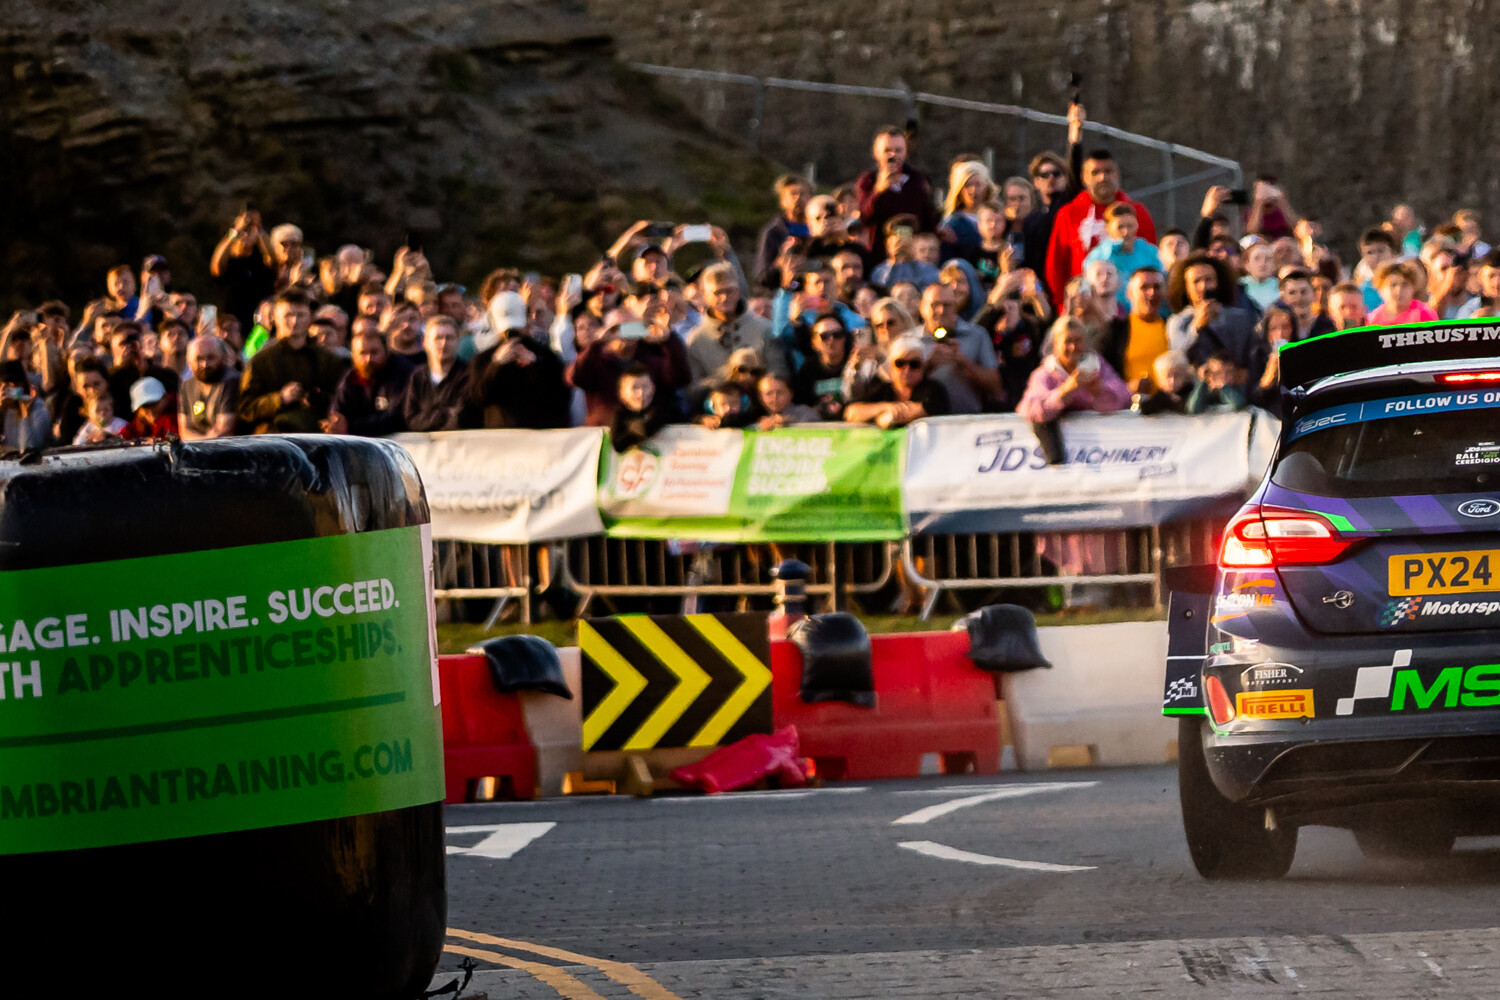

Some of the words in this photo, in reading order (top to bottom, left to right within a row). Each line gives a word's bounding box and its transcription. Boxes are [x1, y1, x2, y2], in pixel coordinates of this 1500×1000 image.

[1385, 395, 1454, 413] FOLLOW
[1456, 393, 1479, 405] US
[1467, 502, 1492, 513] Ford
[1404, 555, 1492, 590] PX24
[109, 595, 259, 643] INSPIRE.
[267, 578, 400, 623] SUCCEED.
[57, 619, 403, 696] APPRENTICESHIPS.
[1254, 668, 1288, 680] FISHER
[1241, 694, 1306, 715] PIRELLI
[1, 738, 413, 820] MBRIANTRAINING.COM
